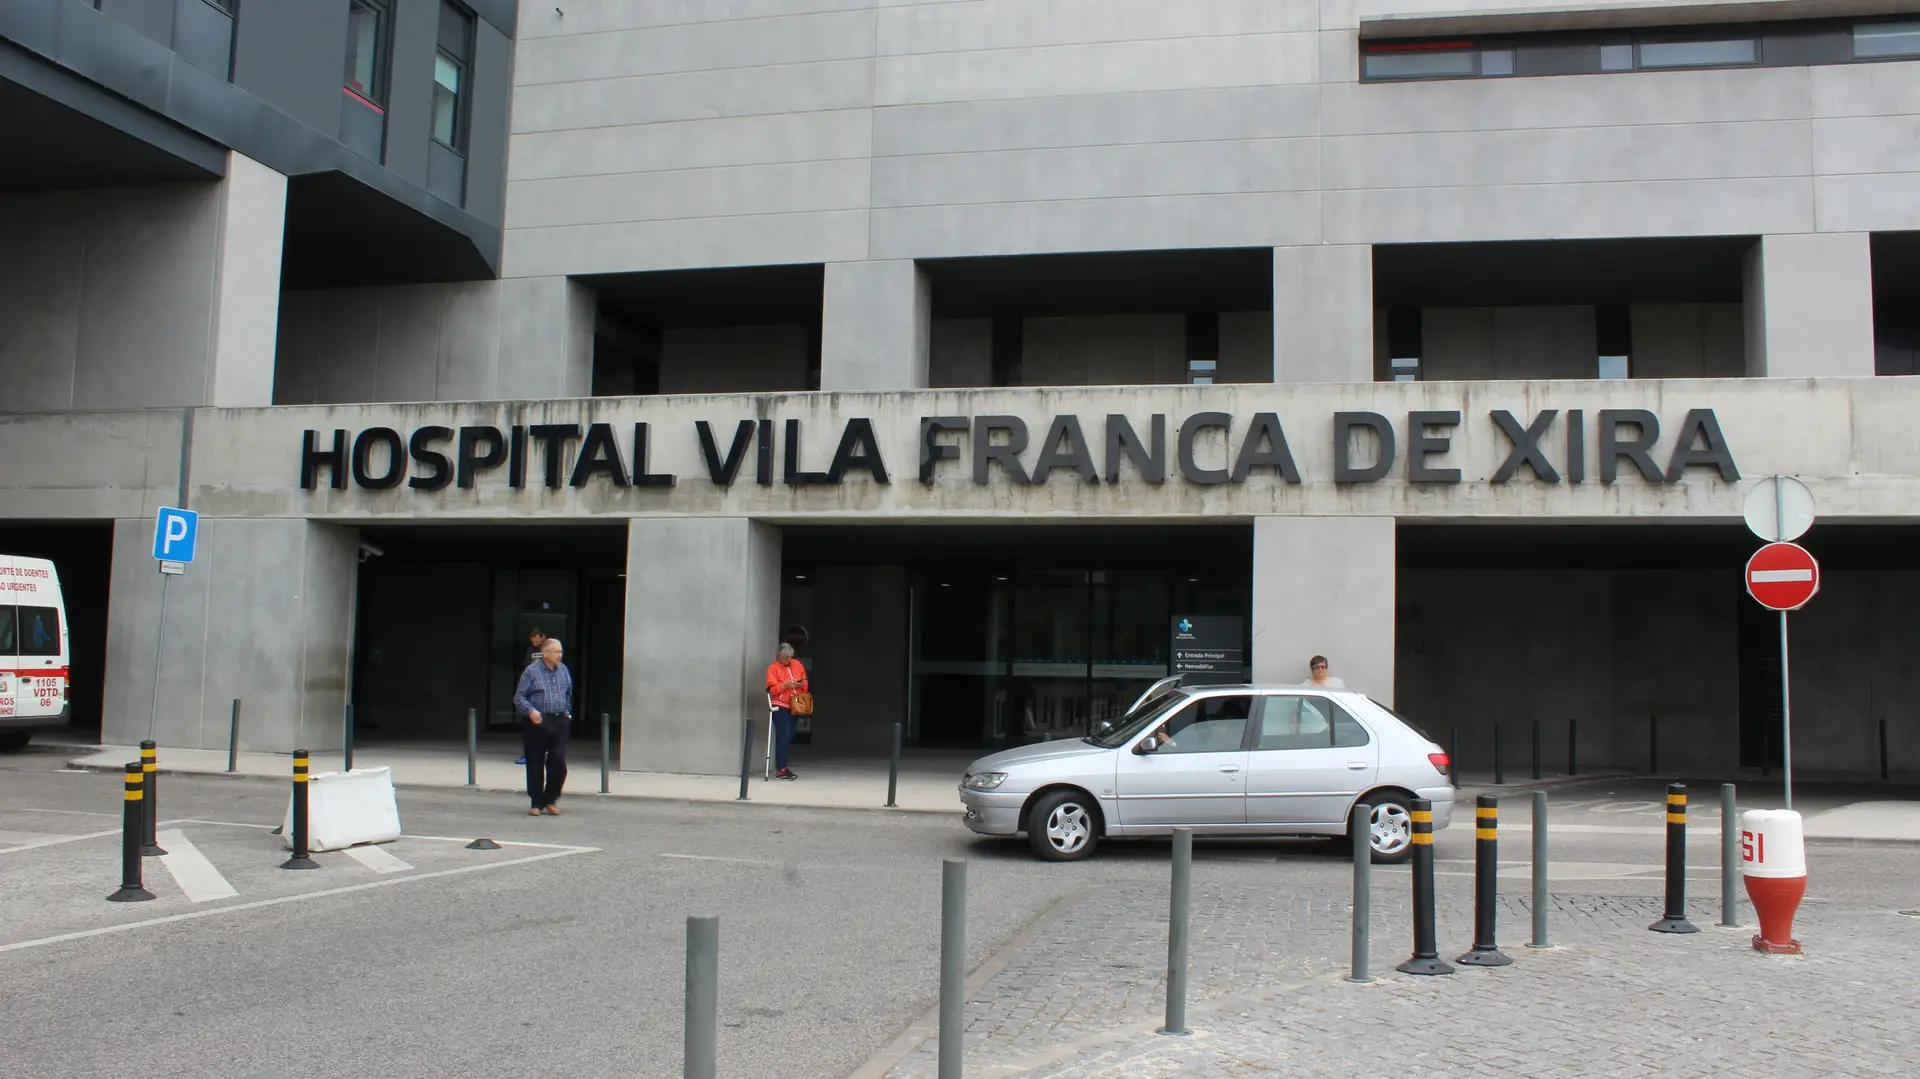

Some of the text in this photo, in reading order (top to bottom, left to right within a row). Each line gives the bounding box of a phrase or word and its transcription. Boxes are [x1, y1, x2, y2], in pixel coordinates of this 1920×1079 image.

[300, 408, 1742, 490] HOSPITAL VILA FRANCA DE XIRA
[163, 514, 188, 554] P
[15, 568, 23, 577] DE
[24, 568, 49, 579] DOENTES
[7, 582, 37, 592] URGENTES
[36, 678, 57, 687] 1105
[33, 688, 59, 697] VDTD
[40, 698, 52, 707] 06
